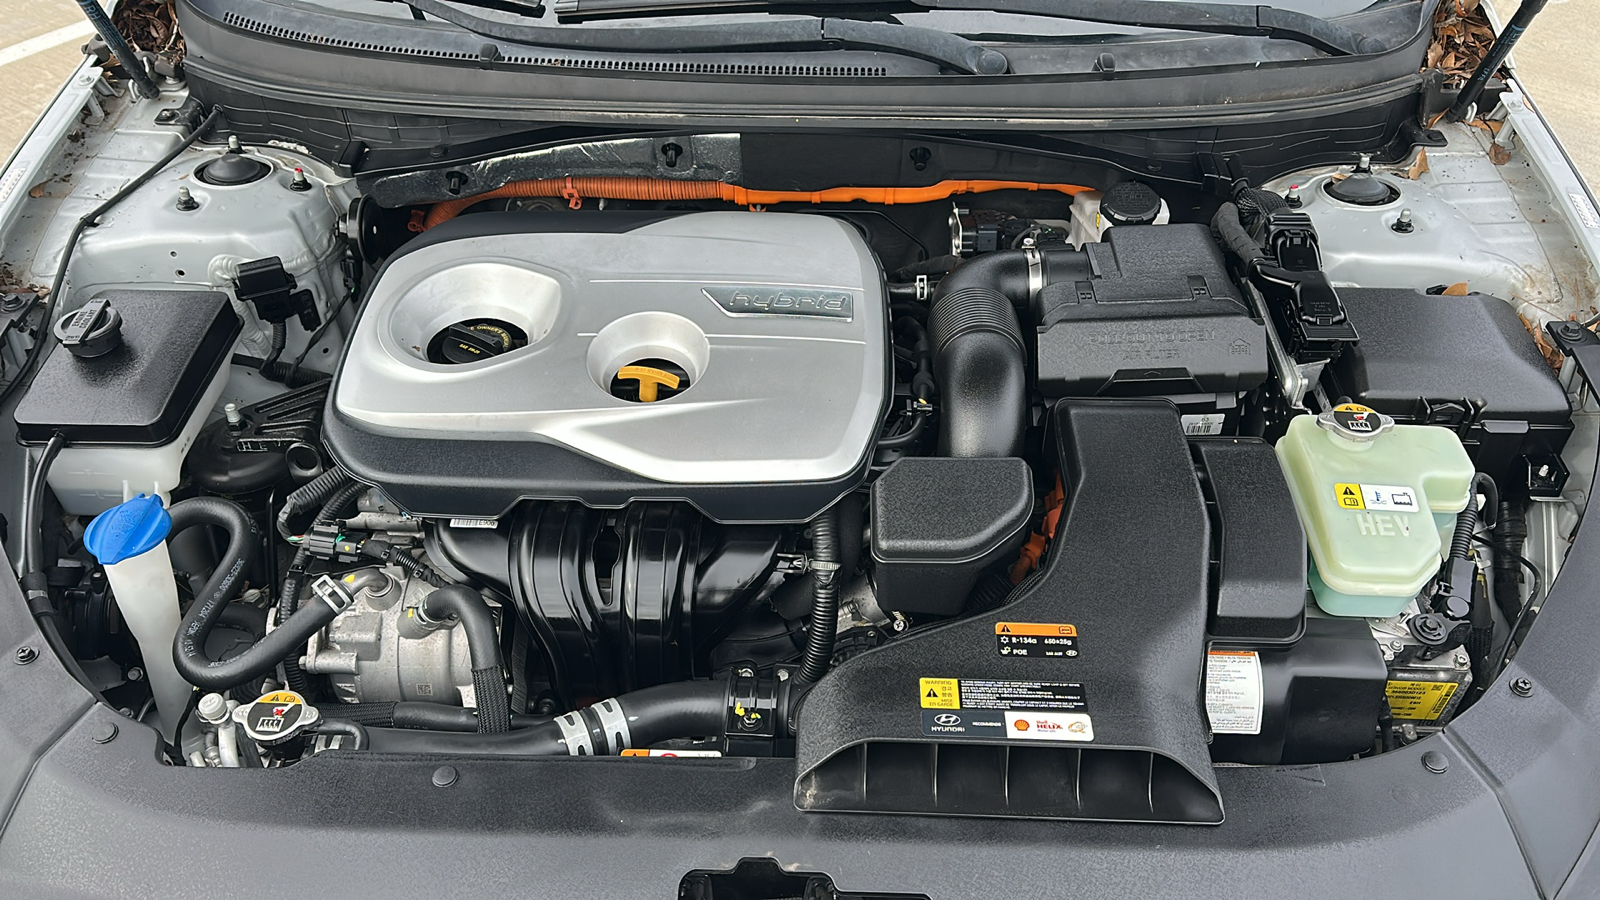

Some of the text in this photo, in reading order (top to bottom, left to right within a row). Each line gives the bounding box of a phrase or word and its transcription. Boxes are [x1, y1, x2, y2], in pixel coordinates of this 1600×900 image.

[729, 291, 847, 310] hybrid
[1178, 329, 1216, 343] OPEN
[1355, 513, 1412, 537] HEV
